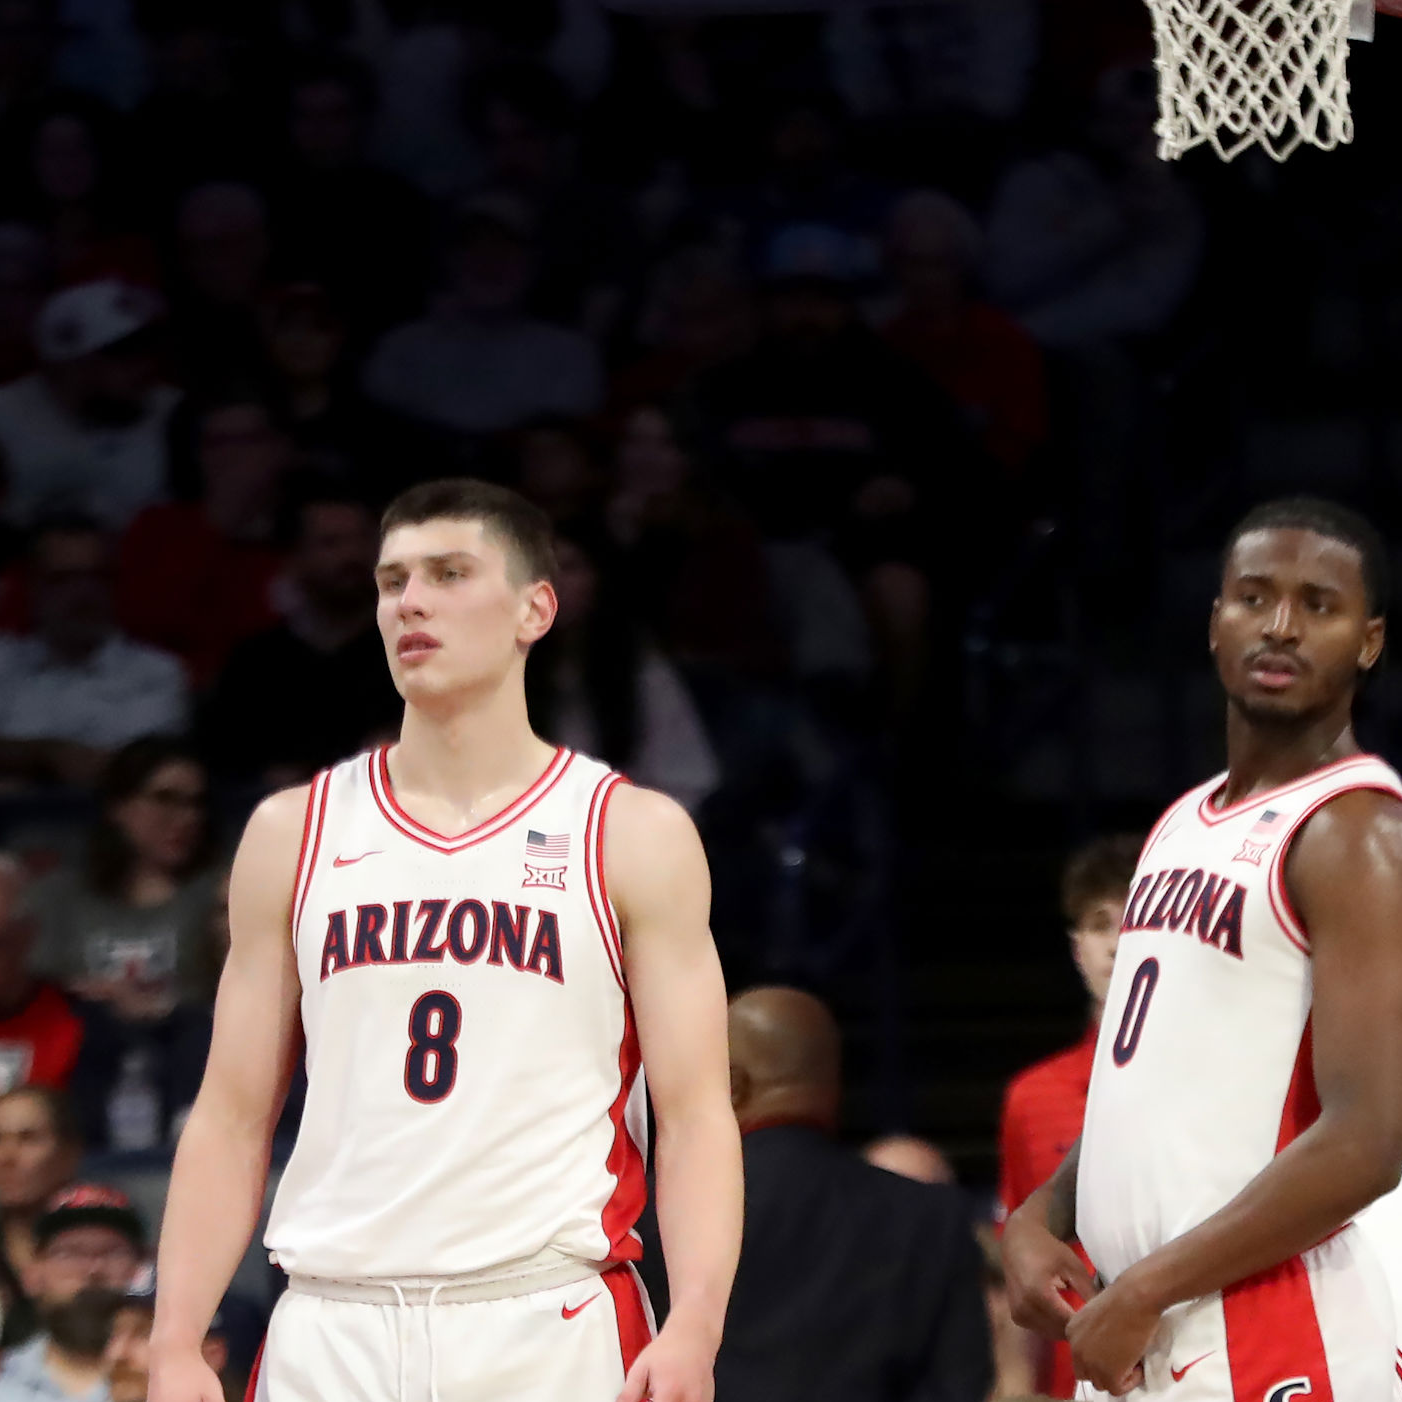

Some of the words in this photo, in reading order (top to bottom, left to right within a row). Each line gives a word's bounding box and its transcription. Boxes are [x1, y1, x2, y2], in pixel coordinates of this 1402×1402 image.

[320, 898, 564, 985] ARIZONA
[1119, 867, 1247, 961] RIZONA
[404, 990, 462, 1104] 8
[1113, 956, 1159, 1068] 0
